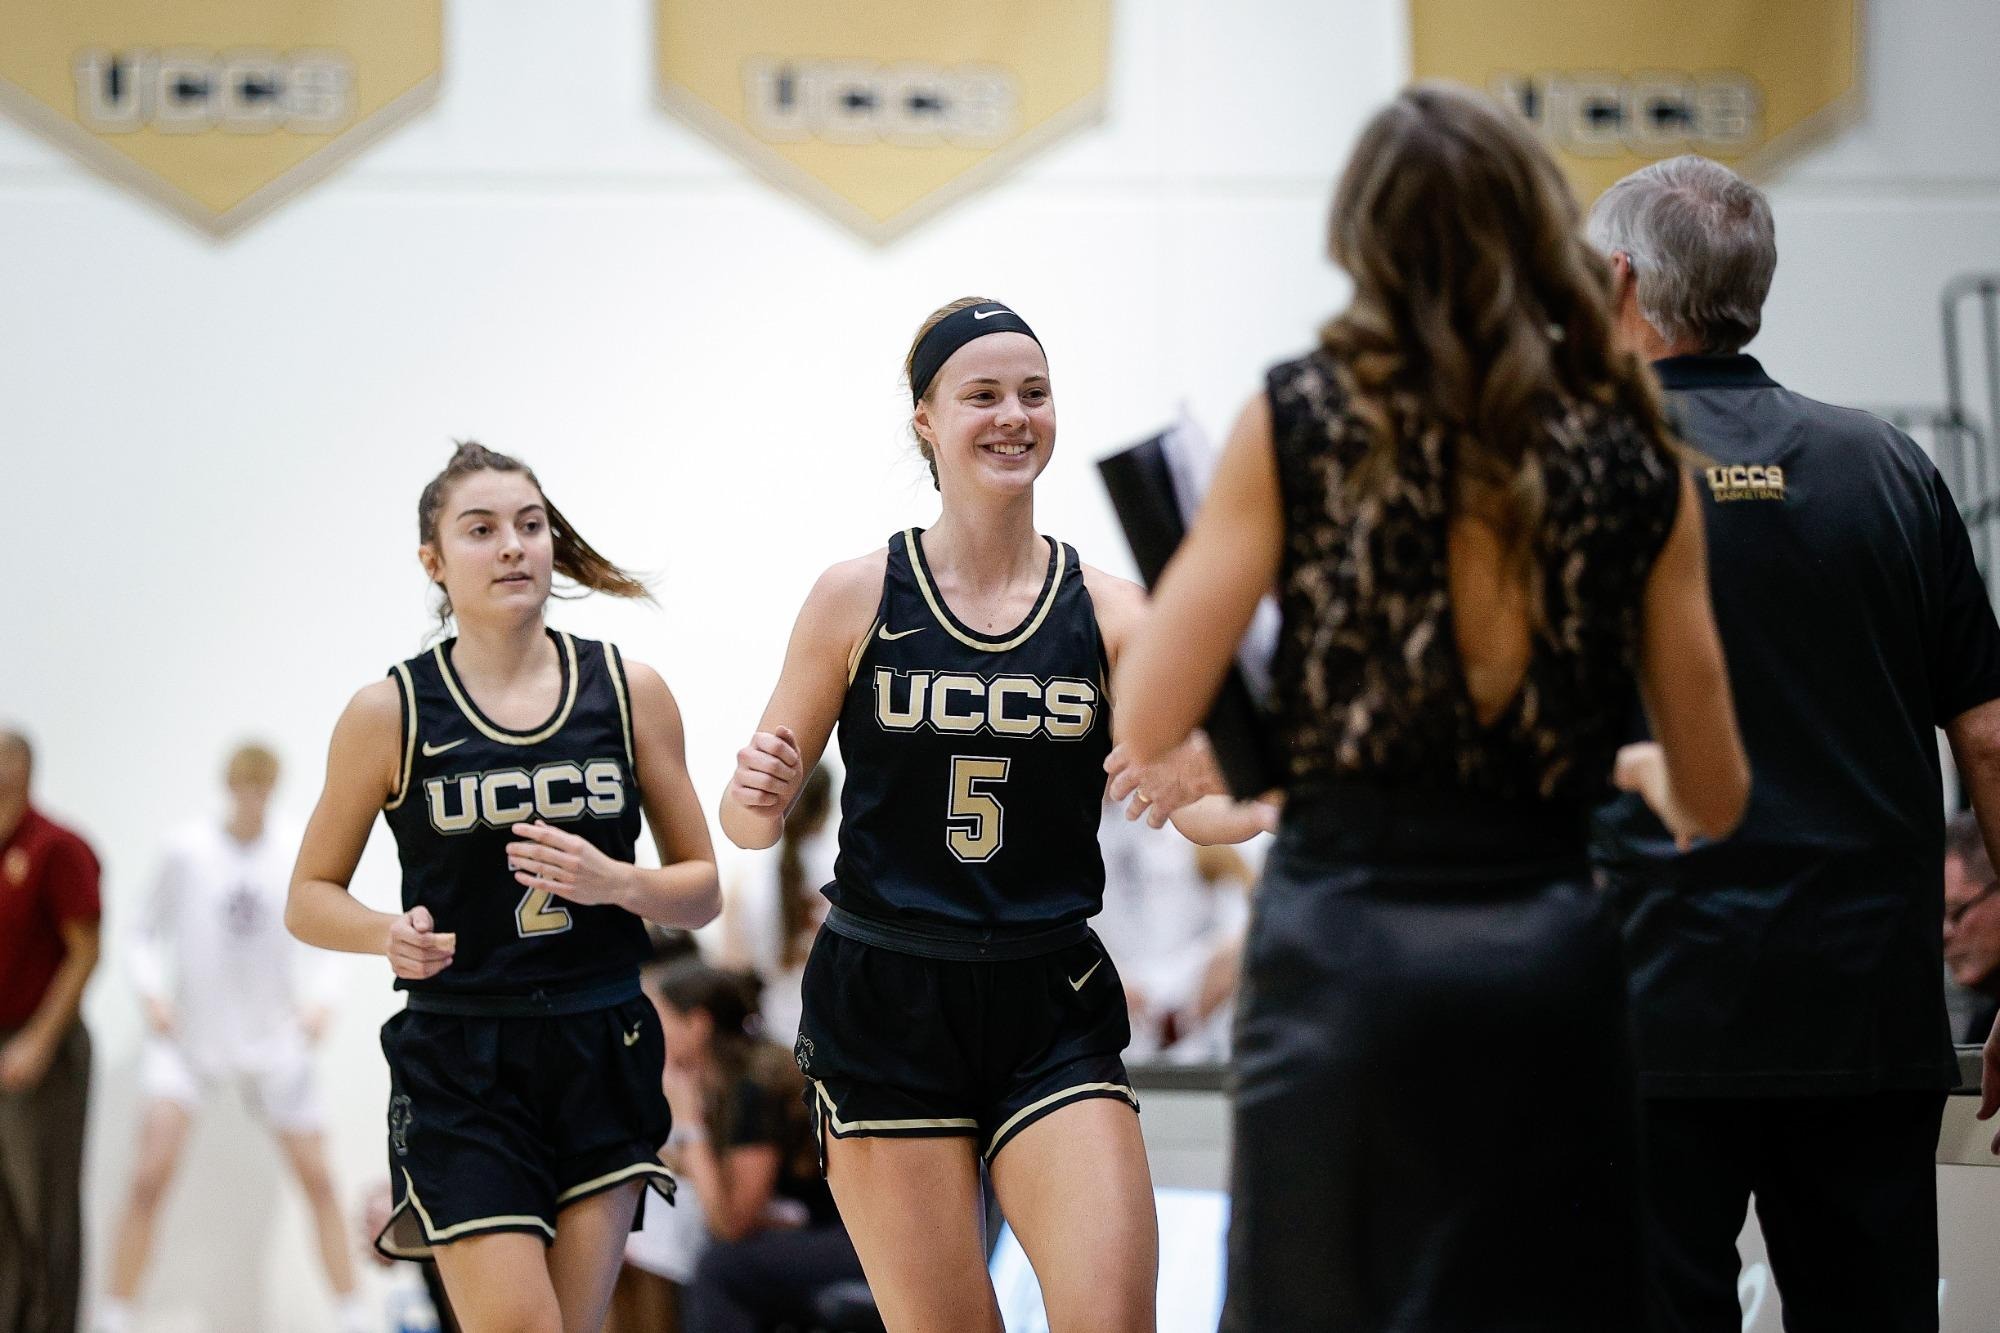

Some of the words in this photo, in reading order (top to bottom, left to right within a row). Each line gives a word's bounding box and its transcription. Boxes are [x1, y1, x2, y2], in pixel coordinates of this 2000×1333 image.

[76, 48, 353, 131] UCCS
[746, 57, 1019, 143] UCCS
[1706, 465, 1783, 489] UCCS
[873, 665, 1098, 741] UCCS
[423, 758, 625, 836] UCCS
[947, 755, 1011, 863] 5
